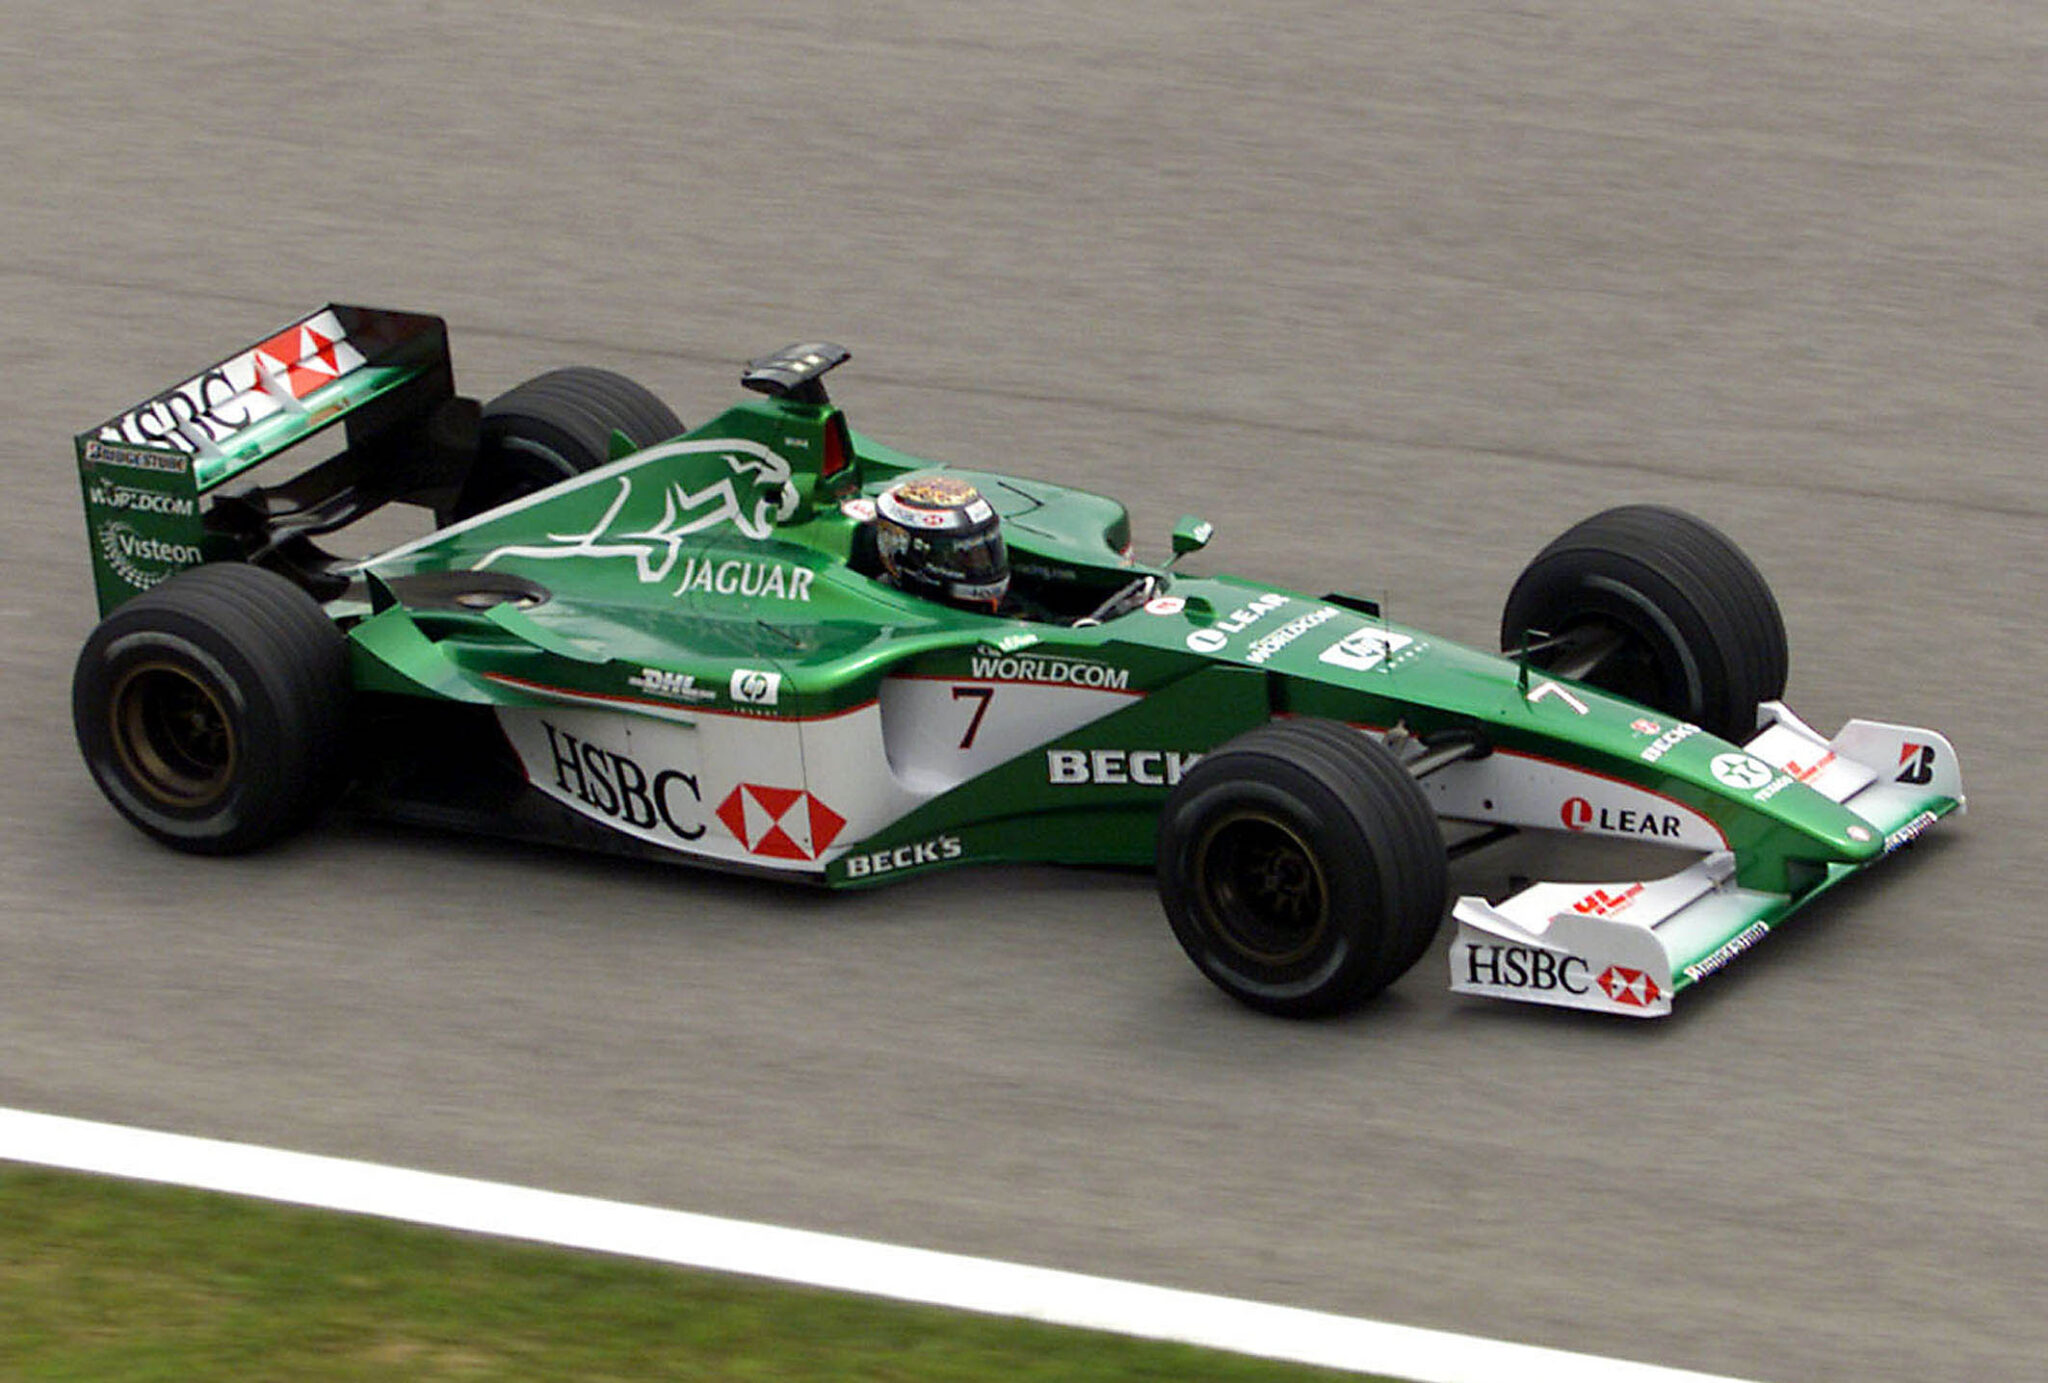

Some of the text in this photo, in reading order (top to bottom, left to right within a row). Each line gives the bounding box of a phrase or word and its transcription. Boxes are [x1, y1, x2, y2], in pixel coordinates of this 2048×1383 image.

[120, 534, 203, 564] Visteon
[673, 558, 815, 602] JAGUAR
[1216, 593, 1290, 633] LEAR
[641, 667, 702, 694] DHL
[972, 656, 1129, 690] WORLDCOM
[952, 687, 994, 750] 7
[1527, 682, 1589, 715] 7
[541, 719, 706, 840] HSBC
[1599, 807, 1680, 837] LEAR
[847, 835, 961, 878] BECK'S
[1466, 944, 1590, 995] HSBC
